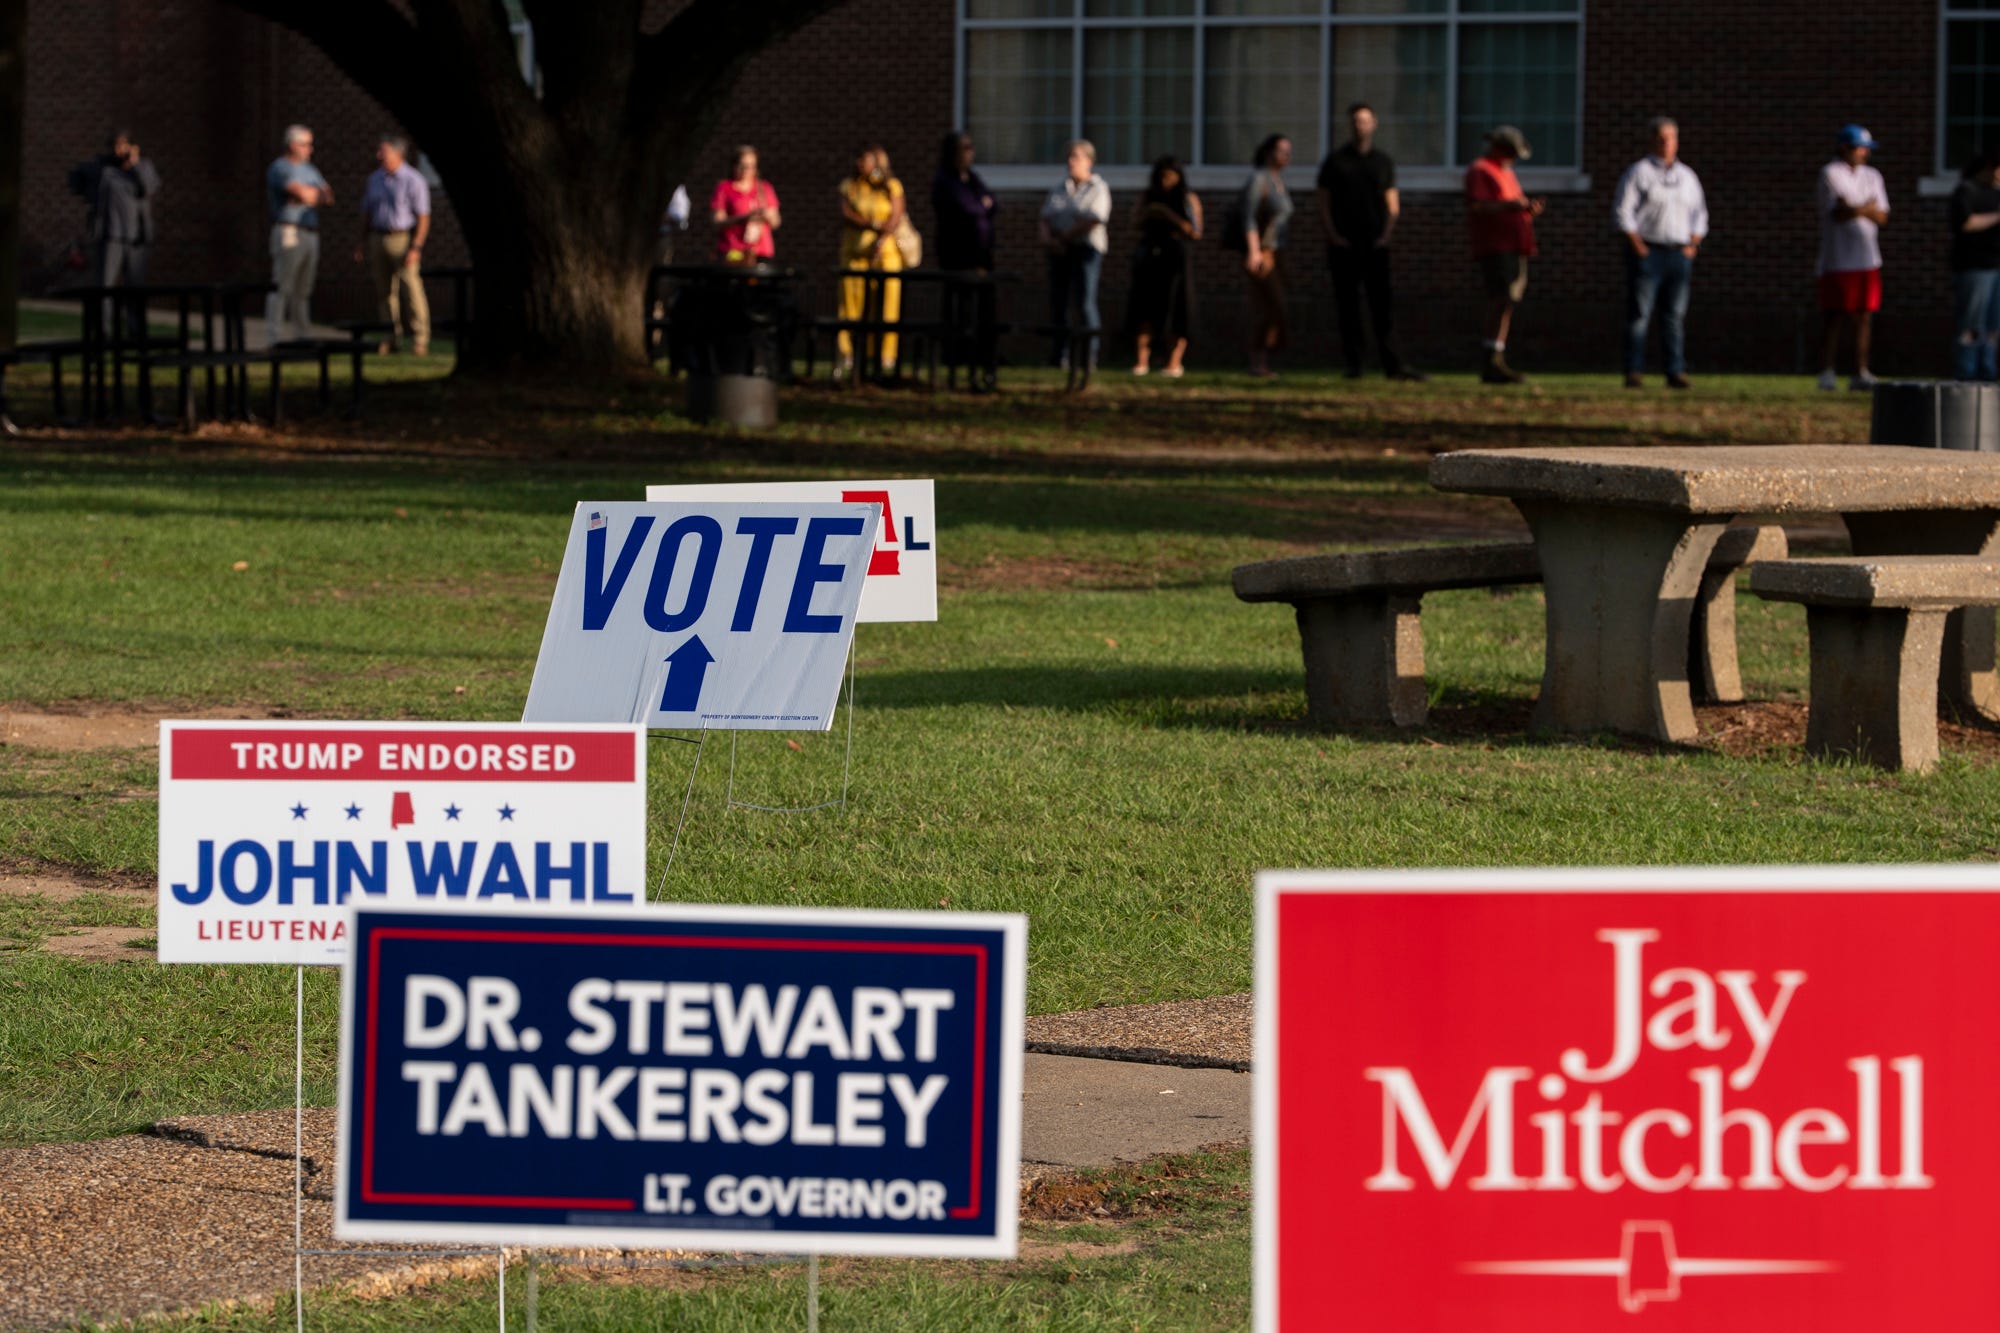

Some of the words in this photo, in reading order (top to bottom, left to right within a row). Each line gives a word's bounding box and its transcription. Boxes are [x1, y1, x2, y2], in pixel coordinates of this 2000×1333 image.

[583, 515, 865, 633] VOTE
[231, 743, 363, 769] TRUMP
[379, 745, 576, 771] ENDORSED
[171, 839, 388, 905] JOHN
[407, 841, 633, 902] WAHL
[198, 920, 346, 941] LIEUTENA
[403, 975, 541, 1052] DR.
[566, 978, 955, 1063] STEWART
[1560, 927, 1806, 1090] Jay
[402, 1061, 949, 1147] TANKERSLEY
[1364, 1055, 1935, 1193] Mitchell
[643, 1174, 694, 1214] LT.
[705, 1174, 947, 1220] GOVERNOR
